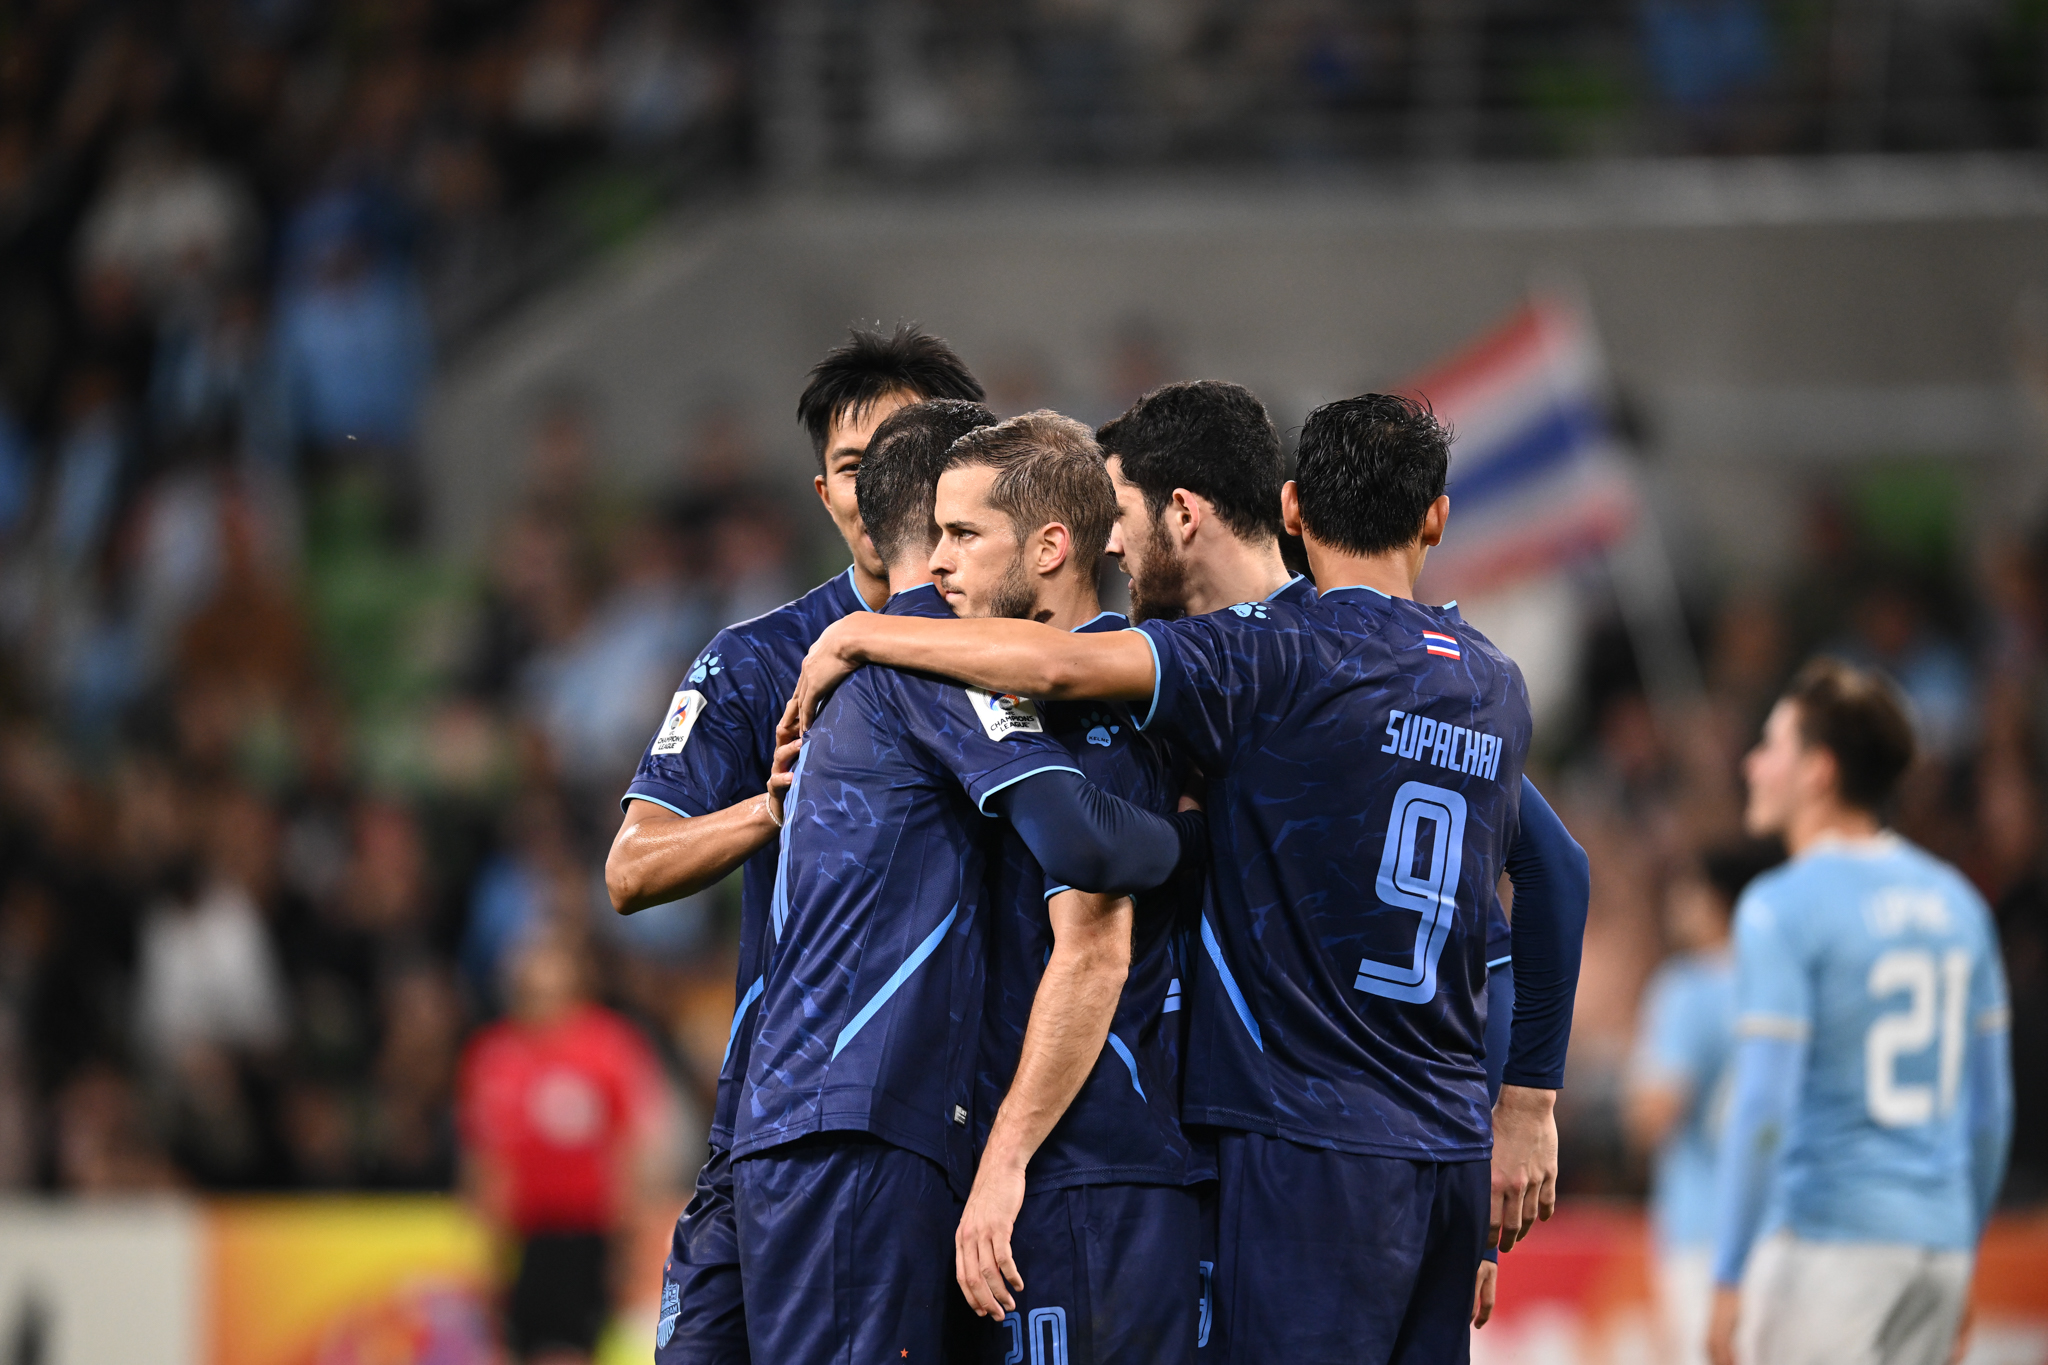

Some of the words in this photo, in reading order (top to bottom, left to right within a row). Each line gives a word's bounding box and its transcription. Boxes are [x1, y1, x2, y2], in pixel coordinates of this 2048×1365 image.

[990, 715, 1034, 731] CHAMPIONS
[1000, 721, 1030, 732] LEAGUE
[1088, 735, 1110, 744] KELME
[1380, 709, 1503, 781] SUPACHAI
[1353, 780, 1467, 1005] 9
[1866, 948, 1971, 1128] 21
